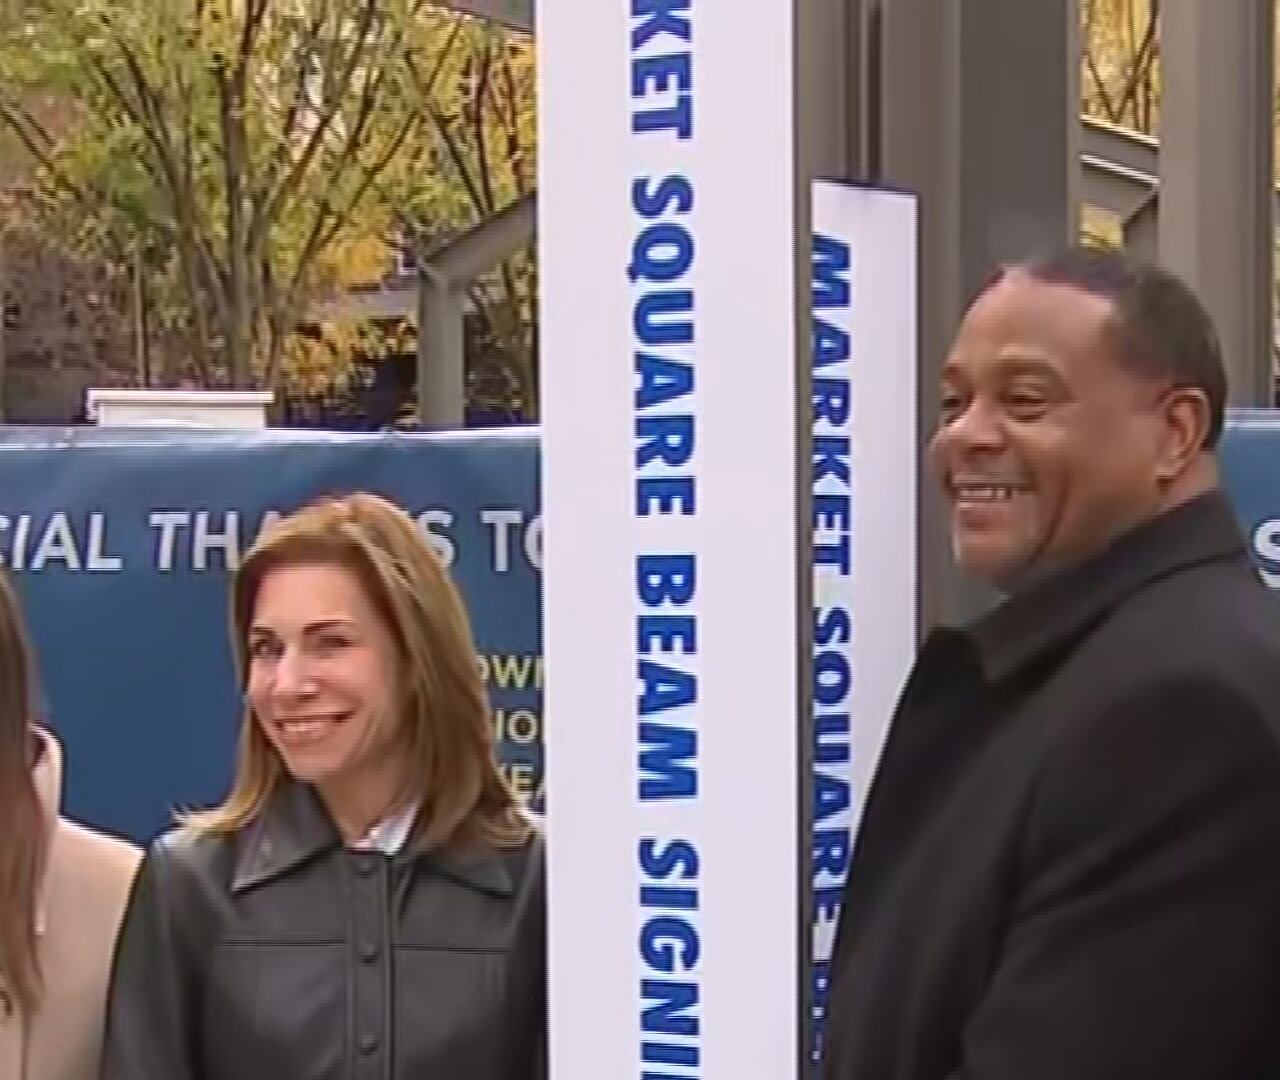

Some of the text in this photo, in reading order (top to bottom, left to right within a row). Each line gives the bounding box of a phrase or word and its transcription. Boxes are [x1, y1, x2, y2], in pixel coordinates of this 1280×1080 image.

[627, 174, 696, 517] SQUARE
[812, 234, 851, 576] MARKET
[149, 510, 456, 572] THS
[636, 554, 698, 801] BEAM
